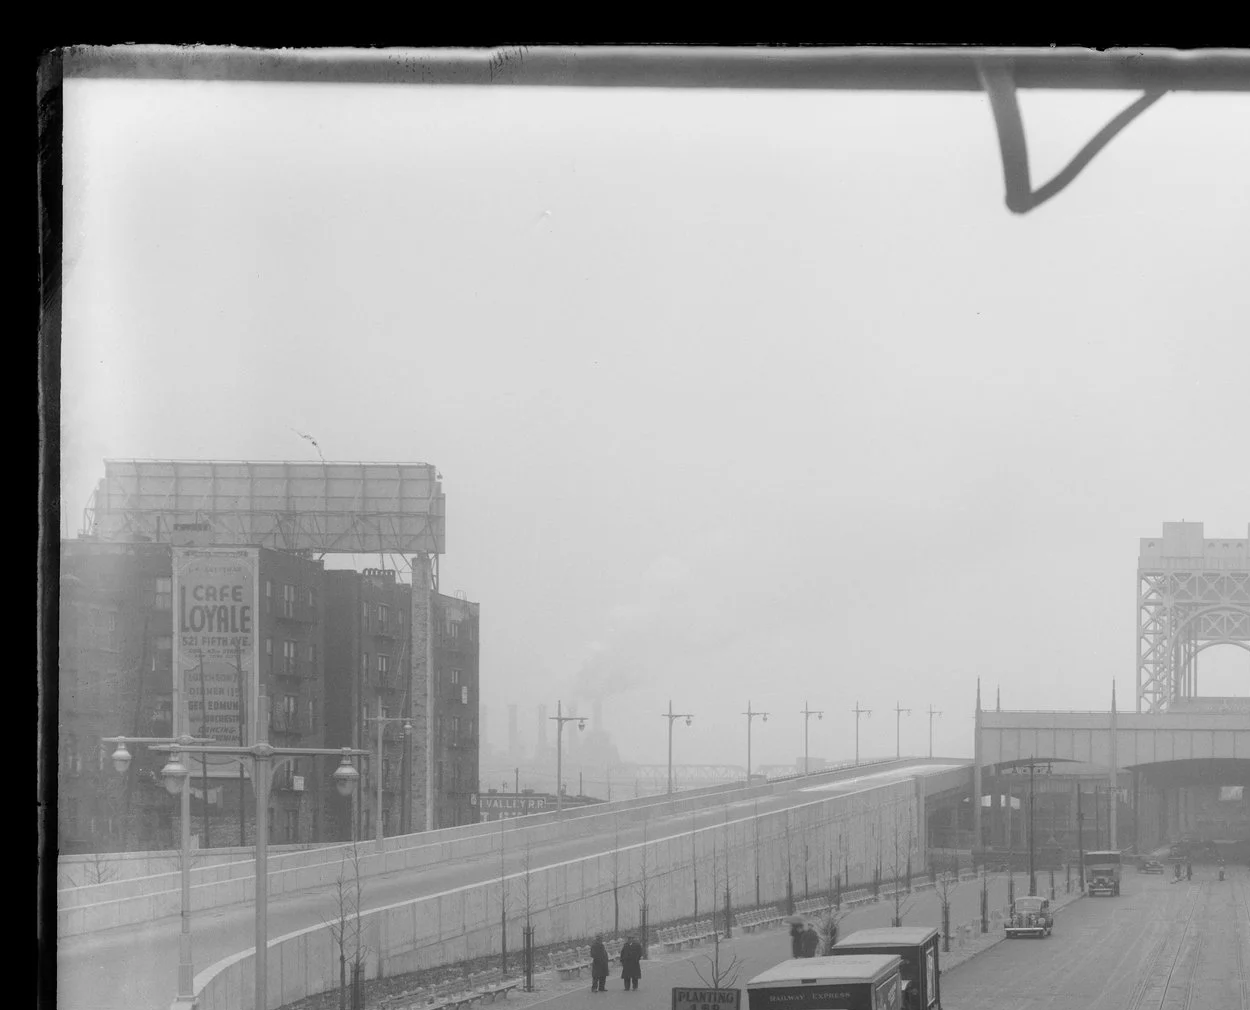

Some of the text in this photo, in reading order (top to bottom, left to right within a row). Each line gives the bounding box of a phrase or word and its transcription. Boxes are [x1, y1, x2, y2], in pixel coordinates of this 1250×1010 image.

[192, 584, 244, 602] CAFE
[181, 585, 251, 633] LOYALE
[182, 636, 198, 646] 521
[201, 636, 228, 646] FIFTH
[198, 726, 237, 734] DNCING
[486, 799, 526, 809] VALLEY
[678, 991, 734, 1004] PLANTING
[769, 991, 851, 1002] RAILWAY EXPRESS
